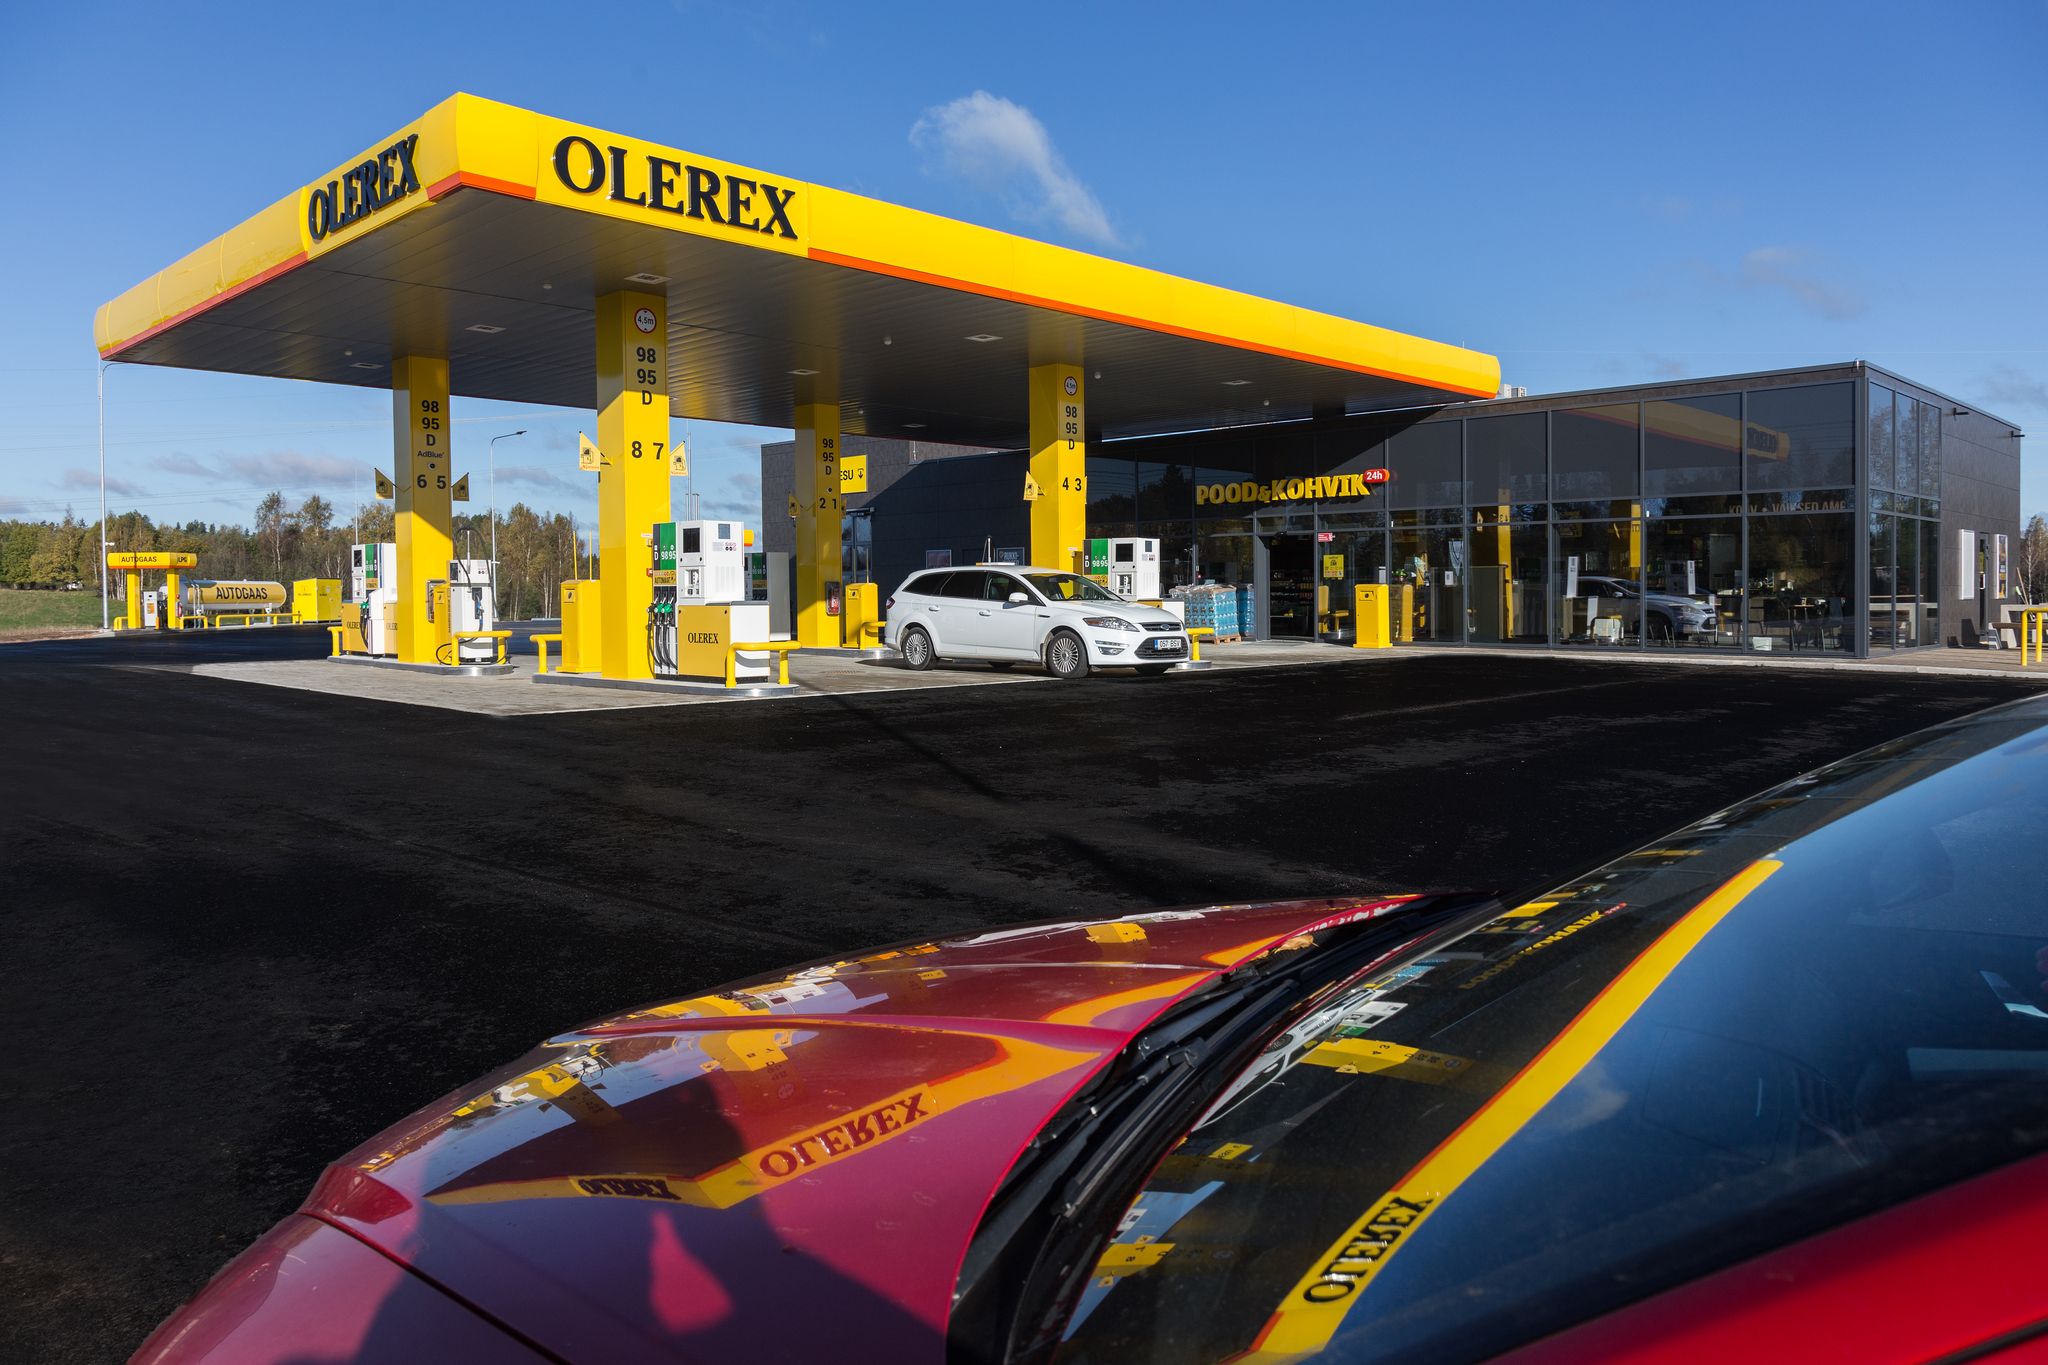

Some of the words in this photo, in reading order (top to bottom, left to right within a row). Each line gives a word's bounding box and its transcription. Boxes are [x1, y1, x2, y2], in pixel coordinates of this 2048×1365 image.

[307, 133, 421, 241] OLEREX
[553, 135, 798, 240] OLEREX
[636, 347, 656, 363] 98
[637, 369, 656, 385] 95
[642, 390, 652, 405] D
[421, 400, 439, 413] 98
[1065, 406, 1077, 418] 98
[421, 417, 439, 430] 95
[1066, 422, 1077, 434] 95
[426, 434, 436, 446] D
[822, 439, 834, 448] 98
[1068, 439, 1075, 450] D
[631, 441, 642, 458] 8
[652, 442, 664, 460] 7
[822, 452, 834, 462] 95
[826, 466, 832, 475] D
[1366, 471, 1383, 481] 24h
[417, 474, 427, 488] 6
[436, 475, 447, 489] 5
[1062, 477, 1069, 490] 4
[1075, 478, 1082, 491] 3
[819, 498, 826, 509] 2
[831, 498, 837, 509] 1
[654, 552, 659, 560] D
[1085, 560, 1090, 568] D
[216, 586, 268, 600] AUTOGAAS
[687, 632, 719, 644] OLEREX
